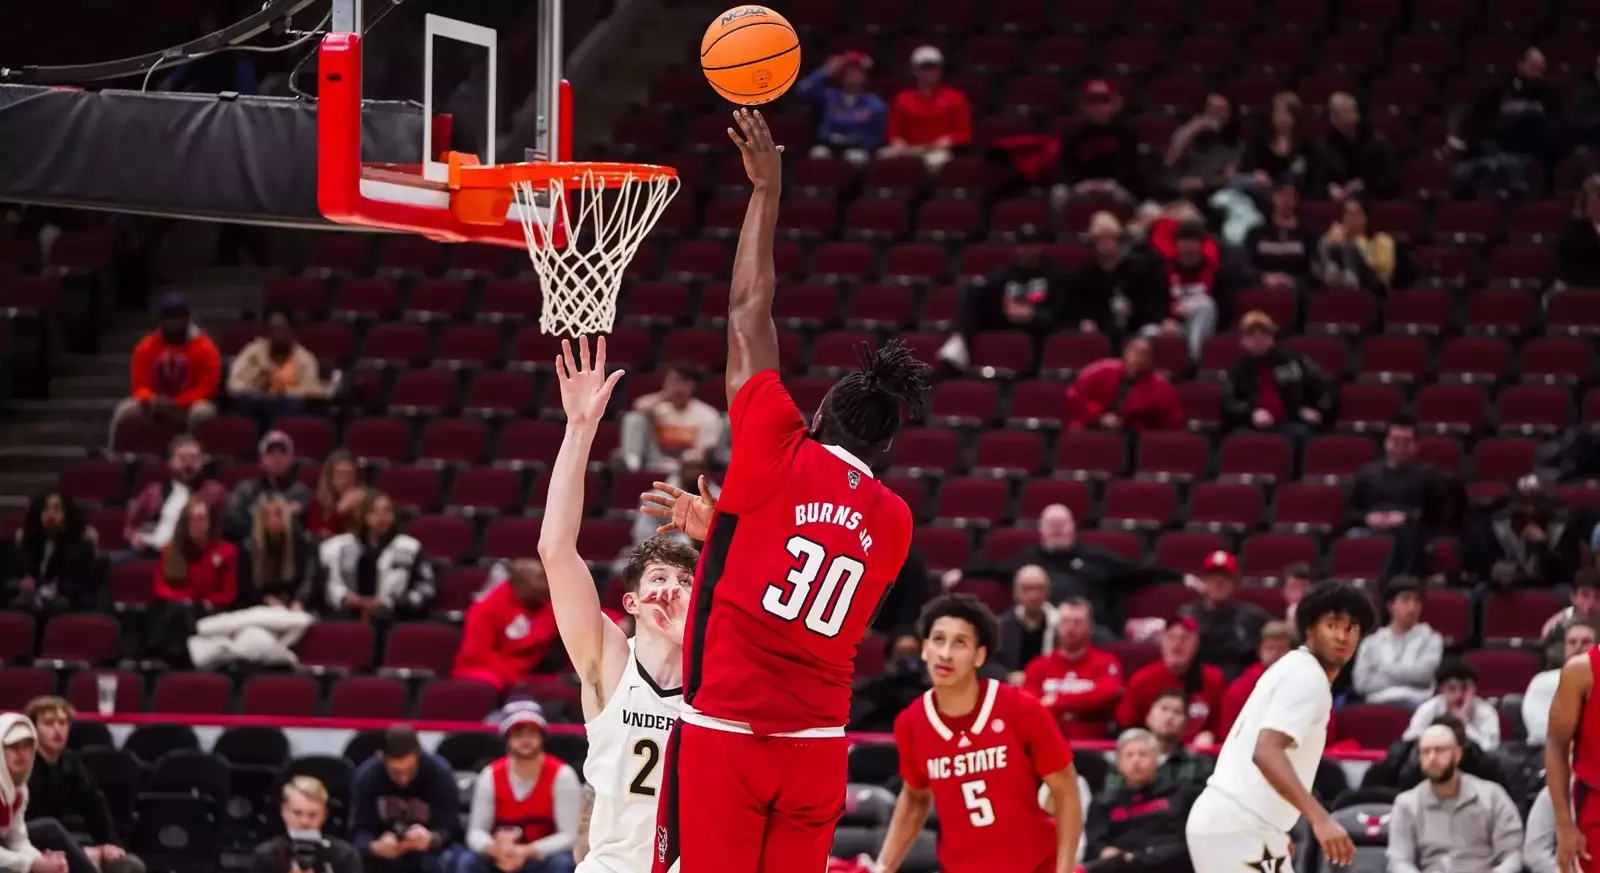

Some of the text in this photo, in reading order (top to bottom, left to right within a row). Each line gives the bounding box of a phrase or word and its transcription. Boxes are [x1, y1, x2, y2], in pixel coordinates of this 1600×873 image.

[721, 8, 767, 26] NCAA
[795, 502, 862, 530] BURNS
[761, 535, 866, 639] 30
[629, 737, 661, 797] 2
[927, 745, 1007, 780] NC STATE
[961, 780, 995, 827] 5
